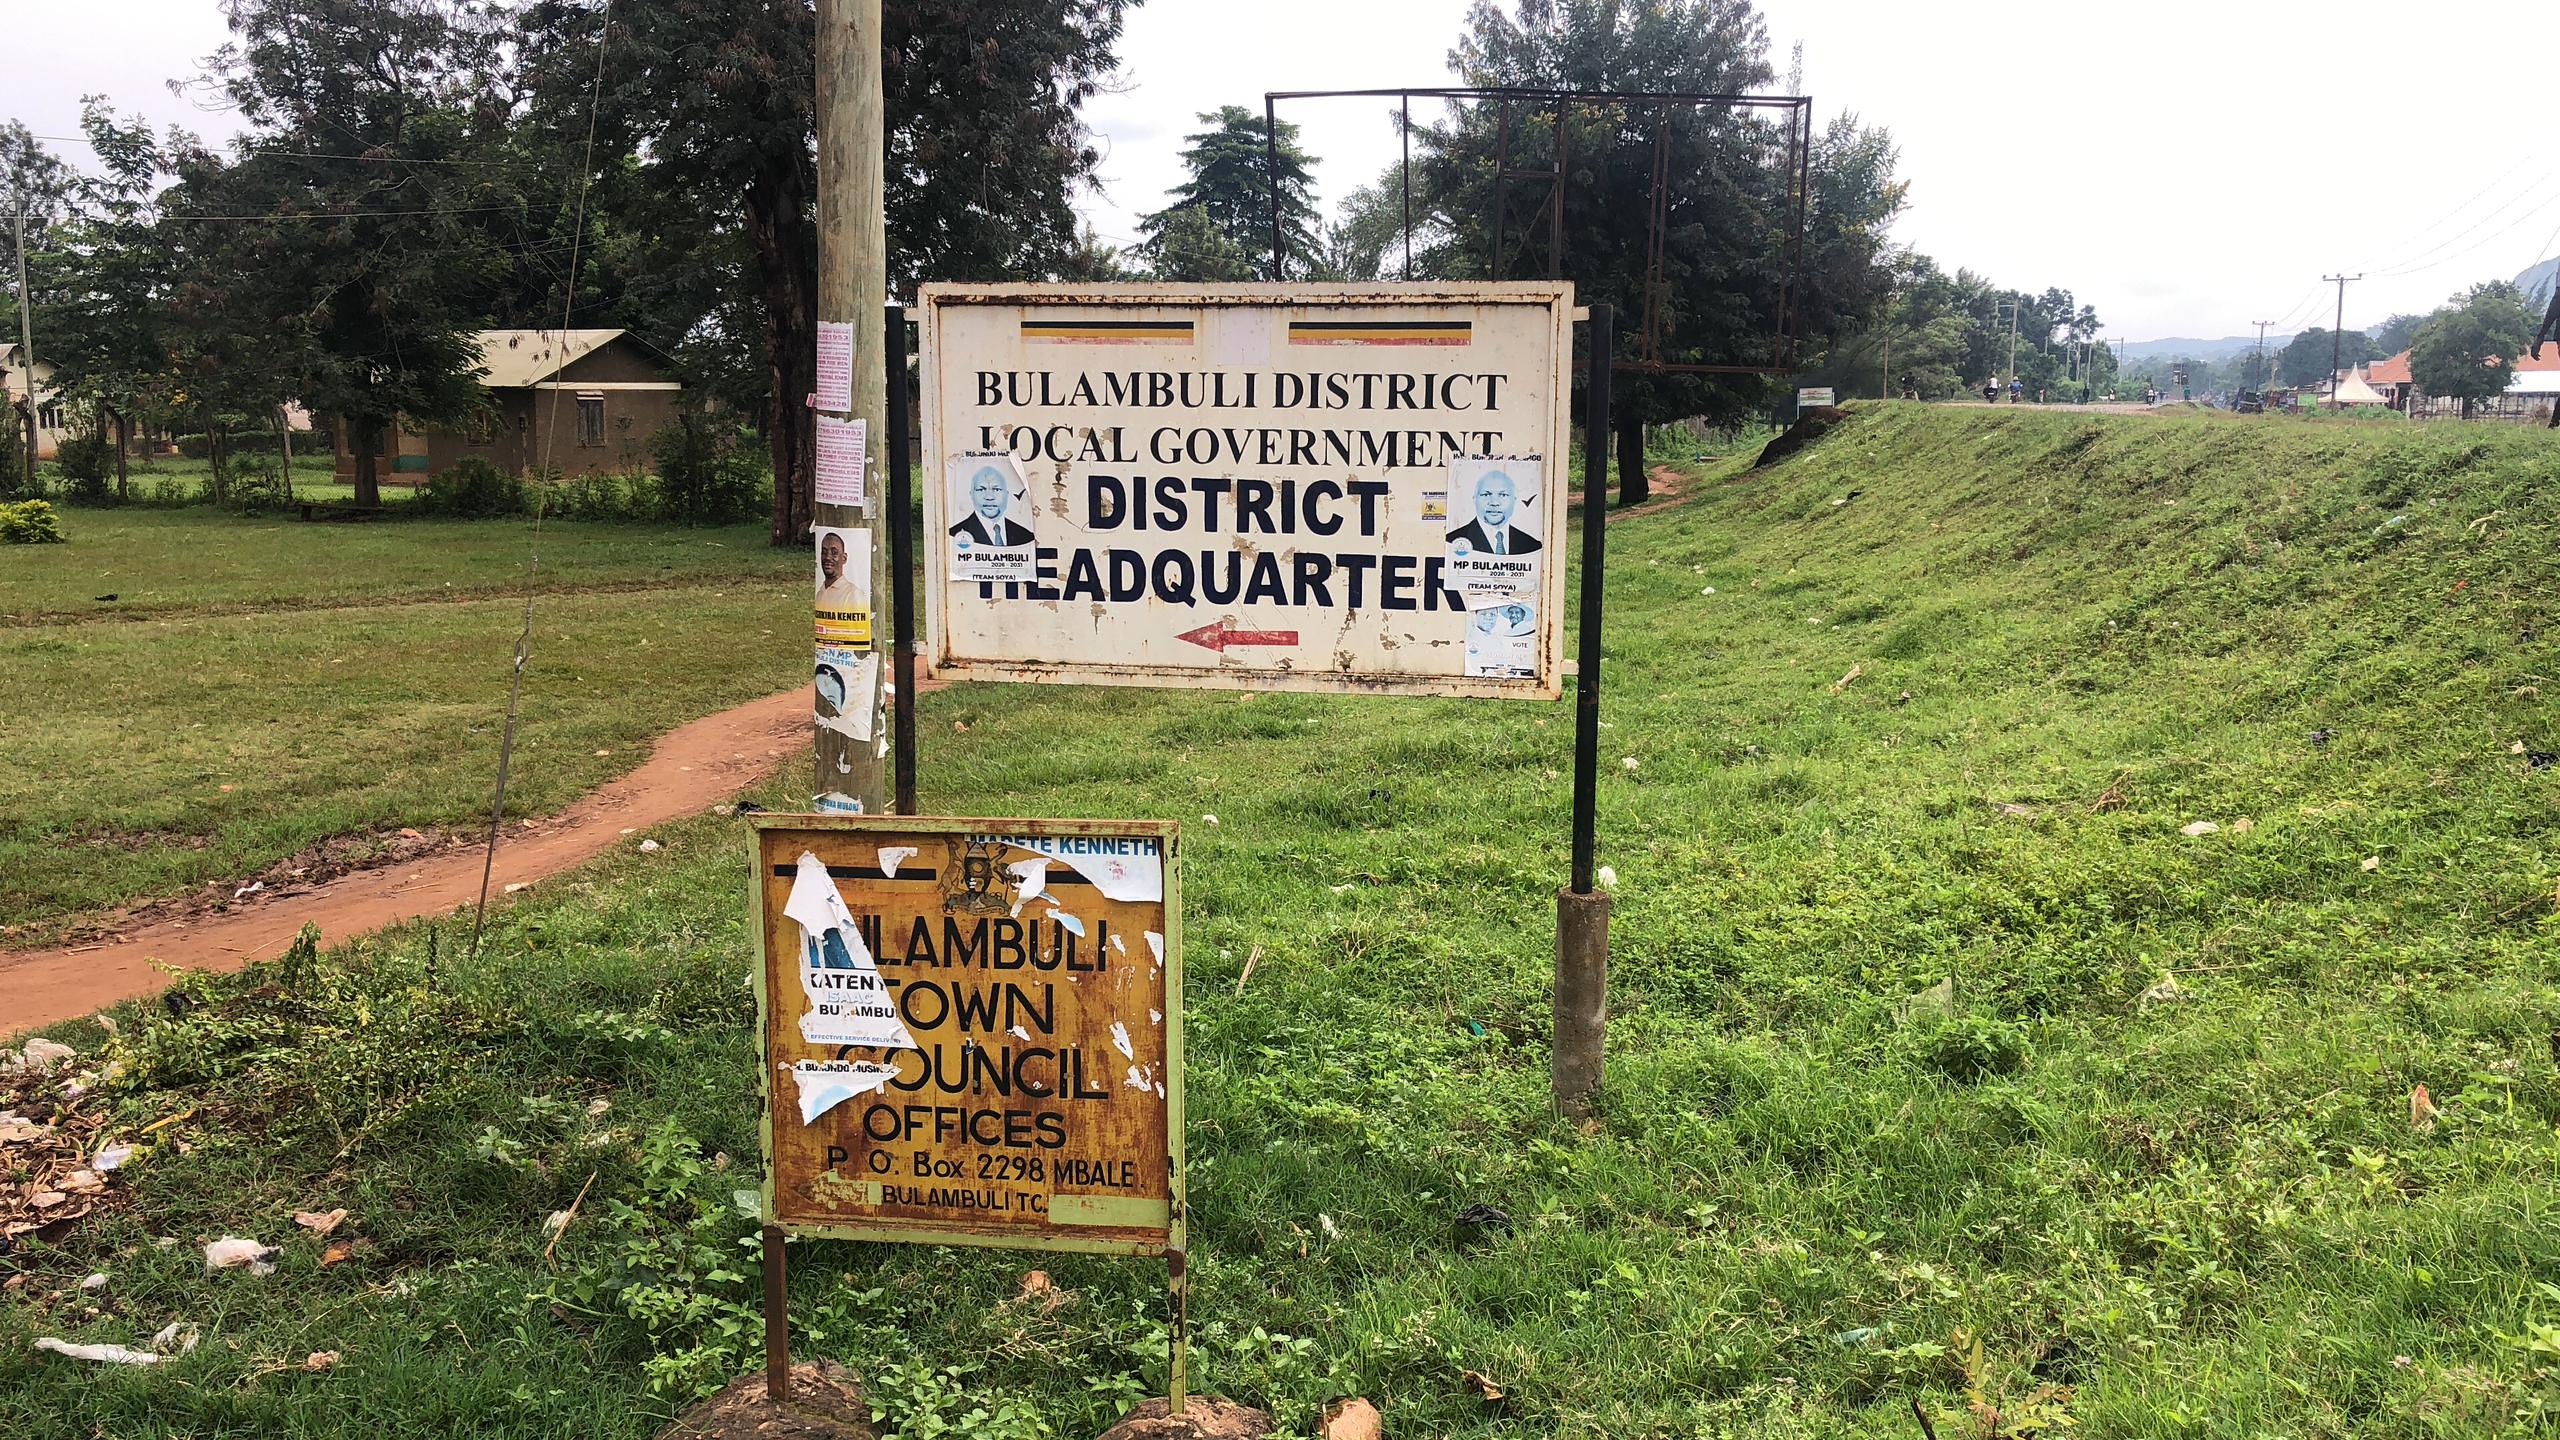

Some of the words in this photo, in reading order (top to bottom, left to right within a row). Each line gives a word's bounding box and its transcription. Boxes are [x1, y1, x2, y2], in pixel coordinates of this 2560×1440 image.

[974, 371, 1258, 408] BULAMBULI
[1272, 372, 1508, 411] DISTRICT
[978, 423, 1138, 463] LOCAL
[1150, 426, 1503, 468] GOVERNMENT
[1088, 475, 1388, 536] DISTRICT
[958, 553, 972, 562] MP
[975, 553, 1029, 562] BULAMBULI
[1453, 561, 1469, 570] MP
[1472, 562, 1532, 572] BULAMBULI
[1493, 584, 1516, 592] SOYA)
[837, 612, 866, 621] KENETH
[1059, 836, 1157, 857] KENNETH
[884, 977, 1054, 1034] OWN
[863, 1104, 1067, 1149] OFFICES
[869, 1149, 899, 1175] O.
[914, 1150, 963, 1178] Box
[977, 1153, 1045, 1183] 2298
[882, 1184, 1011, 1211] BULAMBULI
